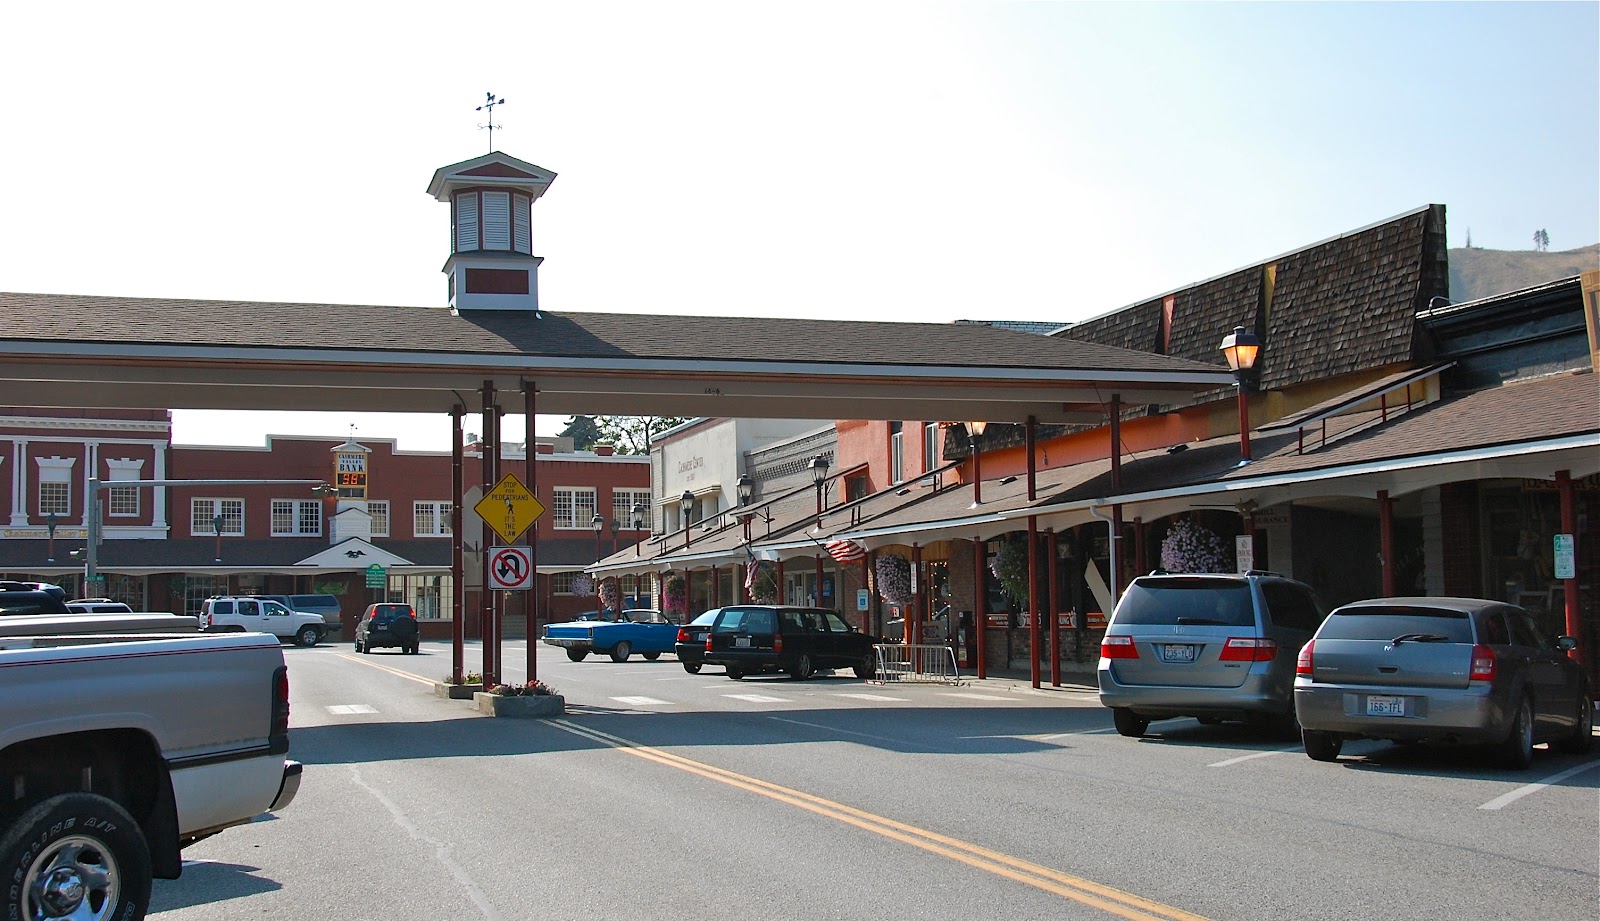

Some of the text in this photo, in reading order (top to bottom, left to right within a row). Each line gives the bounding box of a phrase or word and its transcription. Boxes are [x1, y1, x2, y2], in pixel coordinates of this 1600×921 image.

[339, 464, 364, 472] BANK
[1370, 702, 1402, 713] 166-TFL
[84, 817, 117, 832] A/T
